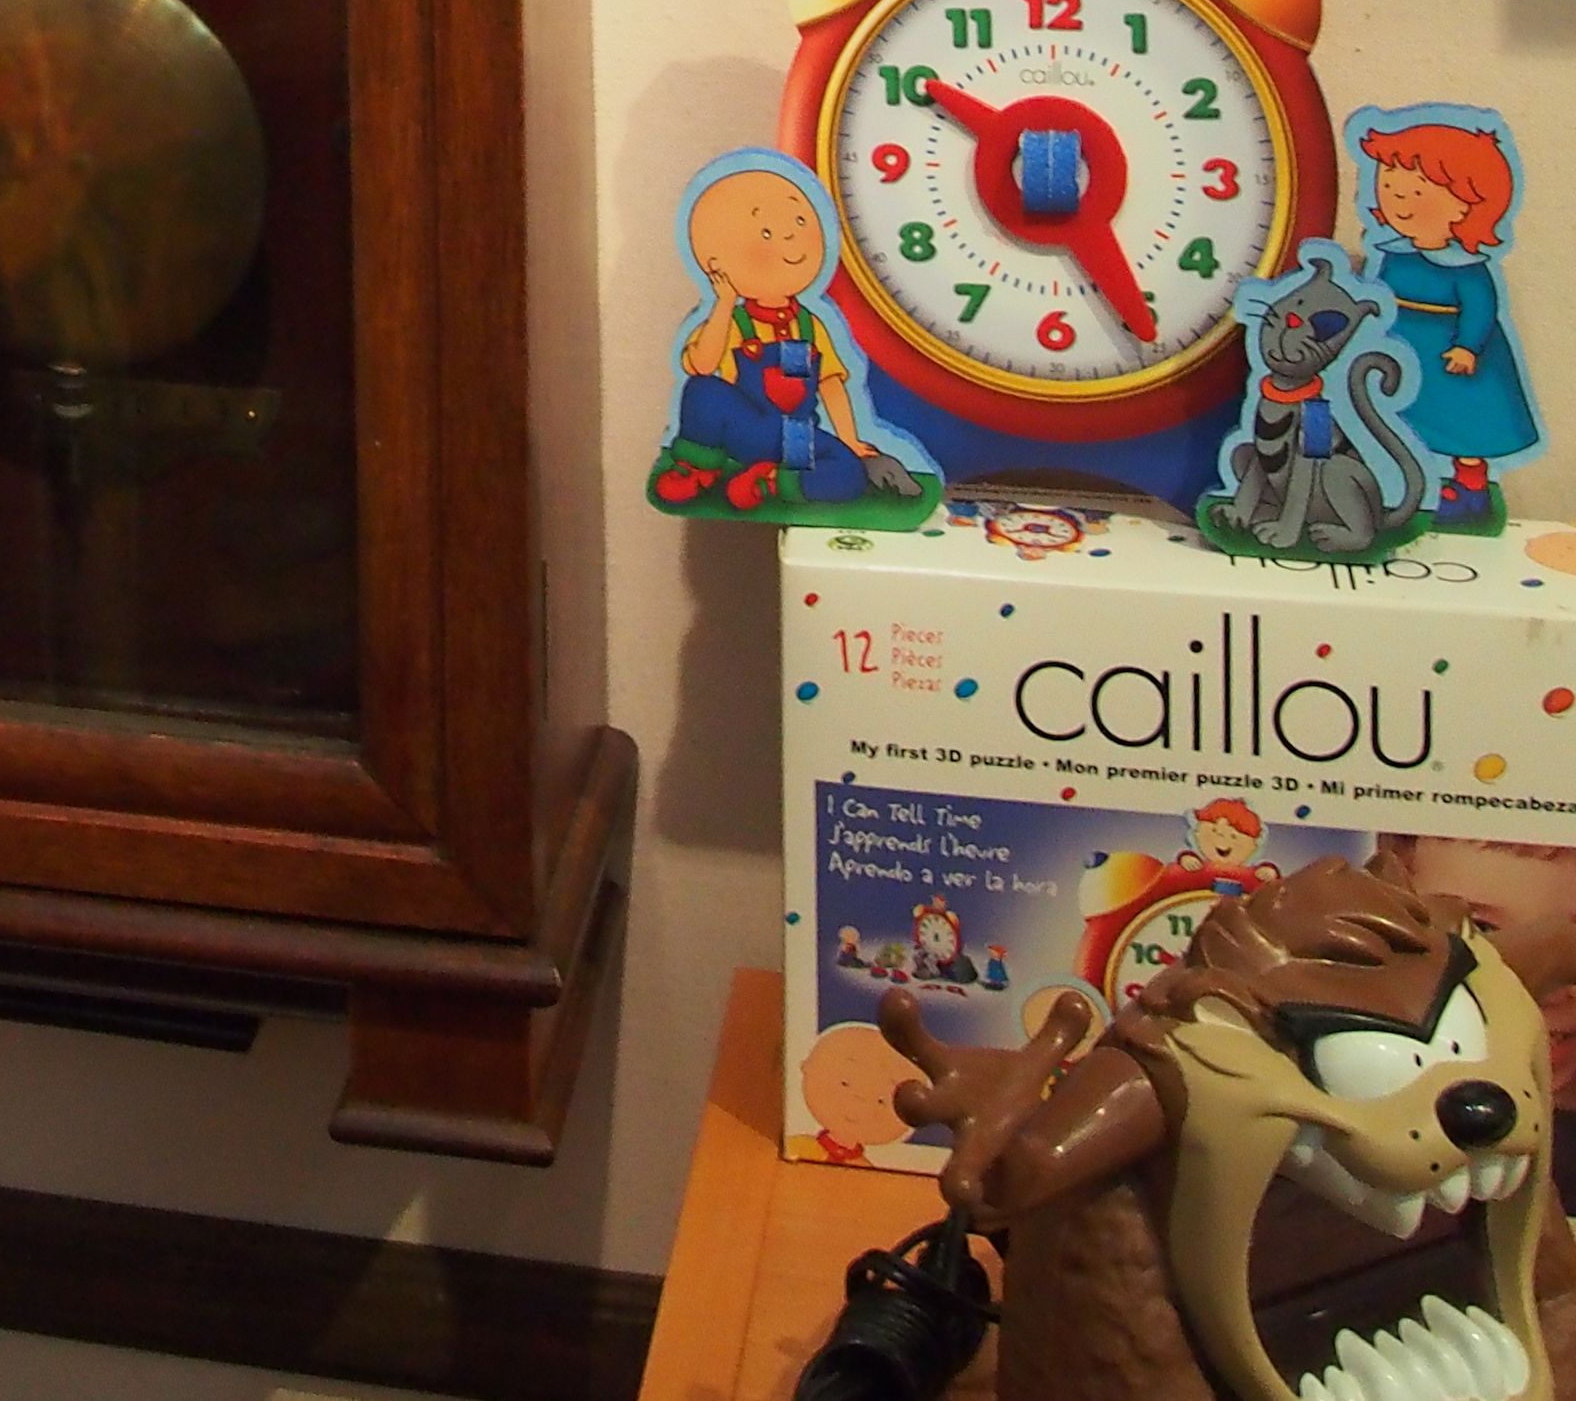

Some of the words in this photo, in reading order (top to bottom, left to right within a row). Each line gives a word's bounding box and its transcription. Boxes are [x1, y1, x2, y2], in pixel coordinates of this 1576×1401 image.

[946, 8, 992, 48] 11
[1124, 13, 1148, 54] 1
[879, 64, 939, 106] 10
[1182, 77, 1221, 119] 2
[871, 144, 910, 182] 9
[1202, 158, 1239, 201] 3
[899, 223, 936, 262] 8
[1179, 237, 1220, 279] 4
[954, 284, 990, 322] 7
[1037, 311, 1075, 352] 6
[833, 629, 879, 673] 12
[891, 623, 943, 644] Pieces
[1014, 611, 1434, 769] caillou
[851, 740, 879, 758] My
[886, 743, 928, 761] first
[937, 747, 962, 763] 3D
[970, 751, 1035, 770] puzzle
[1056, 759, 1098, 776] Mon
[1107, 763, 1188, 785] premier
[1197, 771, 1262, 790] puzzle
[1272, 776, 1298, 792] 3D
[1321, 780, 1345, 796] Mi
[1353, 784, 1423, 803] primer
[843, 797, 880, 820] Can
[889, 801, 925, 826] Tell
[935, 804, 983, 831] Time
